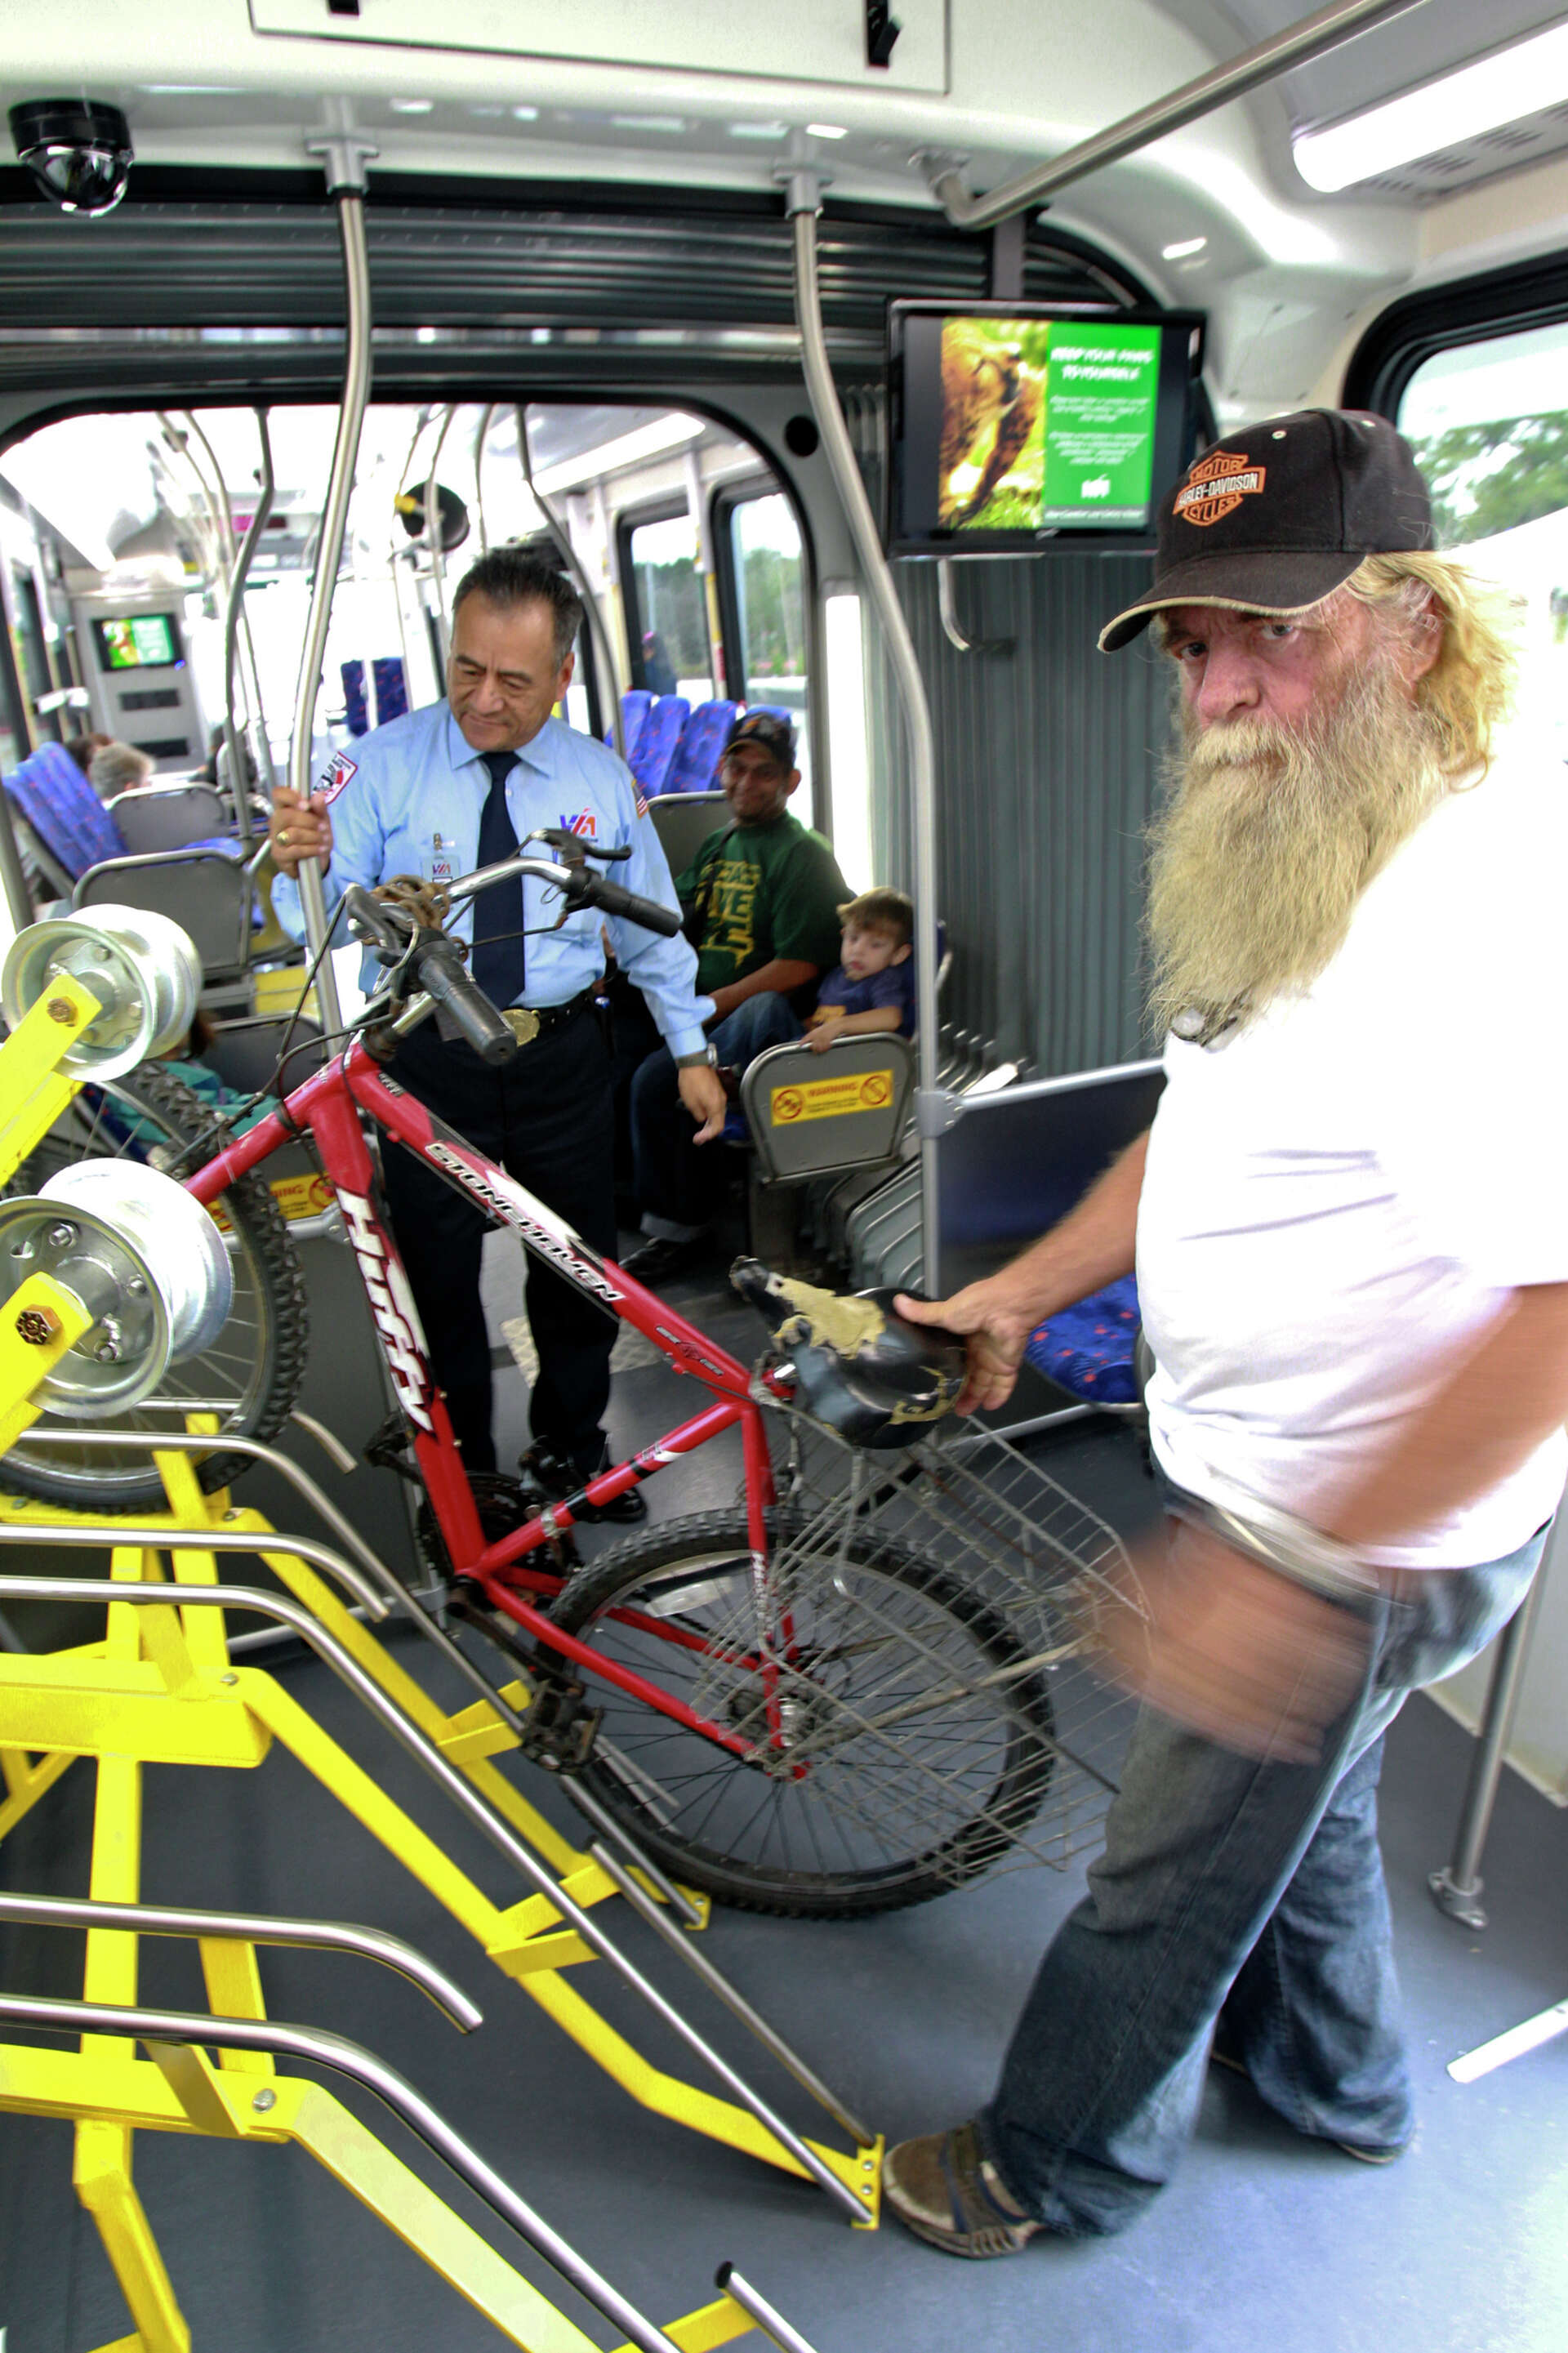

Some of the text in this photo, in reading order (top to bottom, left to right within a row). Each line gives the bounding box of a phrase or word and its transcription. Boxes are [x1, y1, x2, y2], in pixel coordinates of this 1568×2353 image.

[1193, 457, 1241, 480] MOTOR
[1178, 472, 1258, 507] HARLEY-DAVIDSON
[1188, 496, 1237, 521] CYCLES
[559, 806, 595, 836] VIA
[425, 1143, 627, 1302] STONEHAVEN
[336, 1188, 434, 1431] HUFFY
